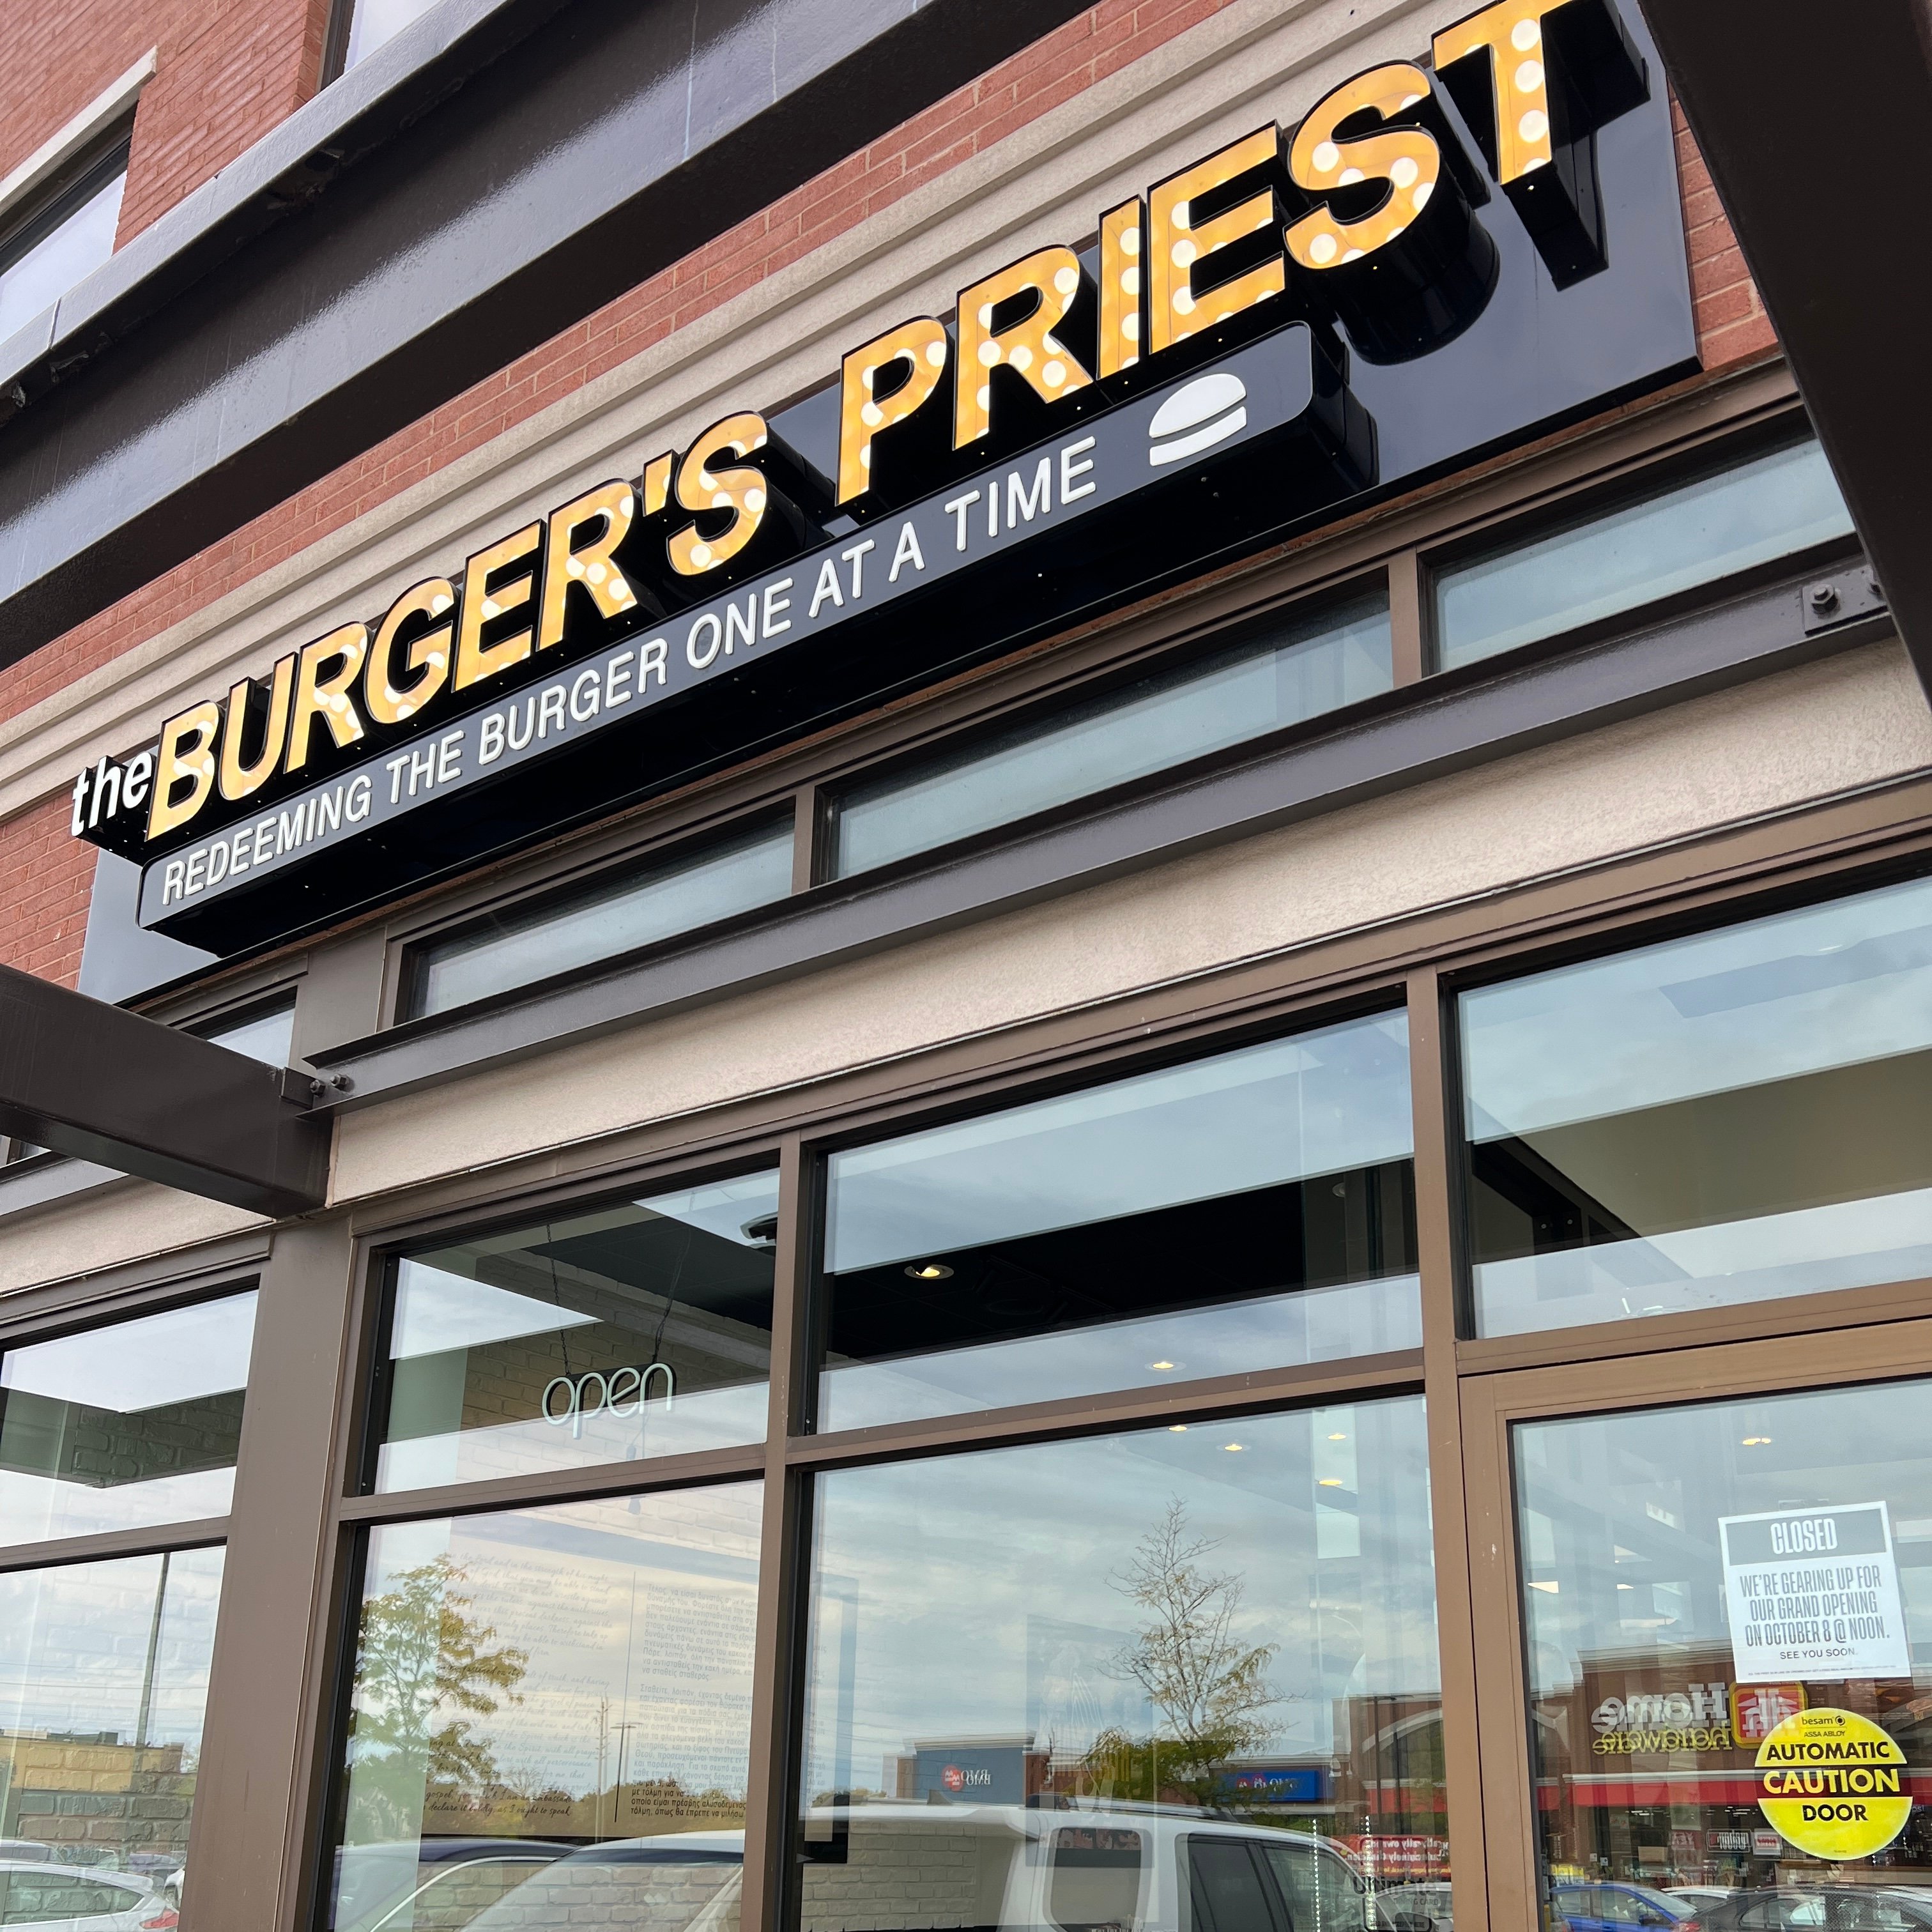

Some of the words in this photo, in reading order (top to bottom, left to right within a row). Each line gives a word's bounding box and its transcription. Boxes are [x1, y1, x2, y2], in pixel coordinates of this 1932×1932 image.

[72, 753, 151, 836] the
[146, 411, 768, 841] BURGER'S
[836, 0, 1573, 505] PRIEST
[163, 774, 371, 905] REDEEMING
[387, 730, 464, 804] THE
[478, 637, 668, 766] BURGER
[686, 576, 793, 669] ONE
[808, 539, 875, 618] AT
[888, 520, 925, 583] A
[944, 435, 1097, 551] TIME
[542, 1363, 675, 1439] open
[1770, 1518, 1838, 1554] CLOSED
[1781, 1568, 1834, 1595] GEARING
[1836, 1567, 1853, 1590] UP
[1856, 1565, 1882, 1588] FOR
[1749, 1598, 1776, 1621] OUR
[1777, 1595, 1820, 1620] GRAND
[1822, 1591, 1878, 1616] OPENING
[1745, 1625, 1763, 1647] ON
[1764, 1620, 1820, 1646] OCTOBER
[1822, 1620, 1832, 1642] 8
[1833, 1619, 1847, 1643] @
[1848, 1616, 1890, 1641] NOON.
[1779, 1651, 1800, 1660] SEE
[1801, 1650, 1823, 1658] YOU
[1767, 1742, 1890, 1761] AUTOMATIC
[1763, 1768, 1900, 1794] CAUTION
[1802, 1804, 1869, 1821] DOOR
